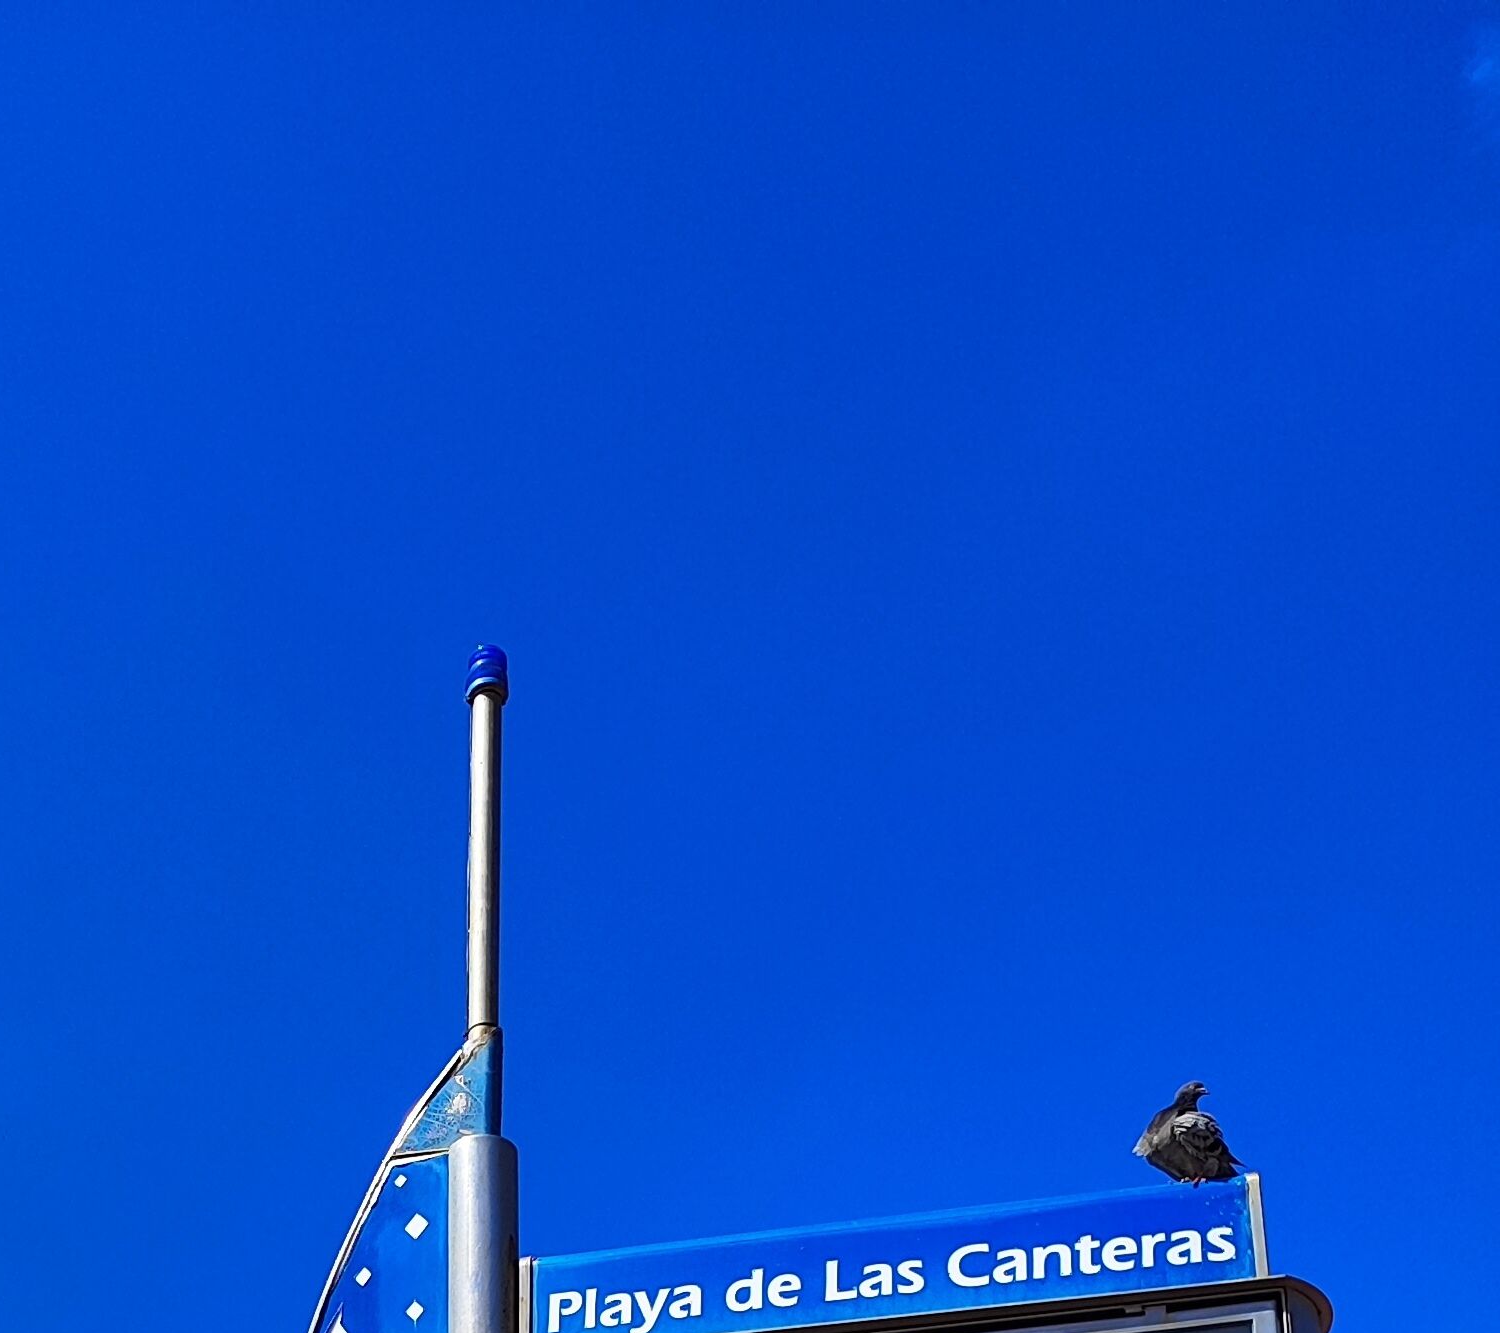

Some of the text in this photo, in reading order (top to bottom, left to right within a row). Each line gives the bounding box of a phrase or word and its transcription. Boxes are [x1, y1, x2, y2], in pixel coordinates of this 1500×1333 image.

[725, 1268, 802, 1312] de
[825, 1260, 925, 1302] Las
[947, 1227, 1236, 1287] Canteras
